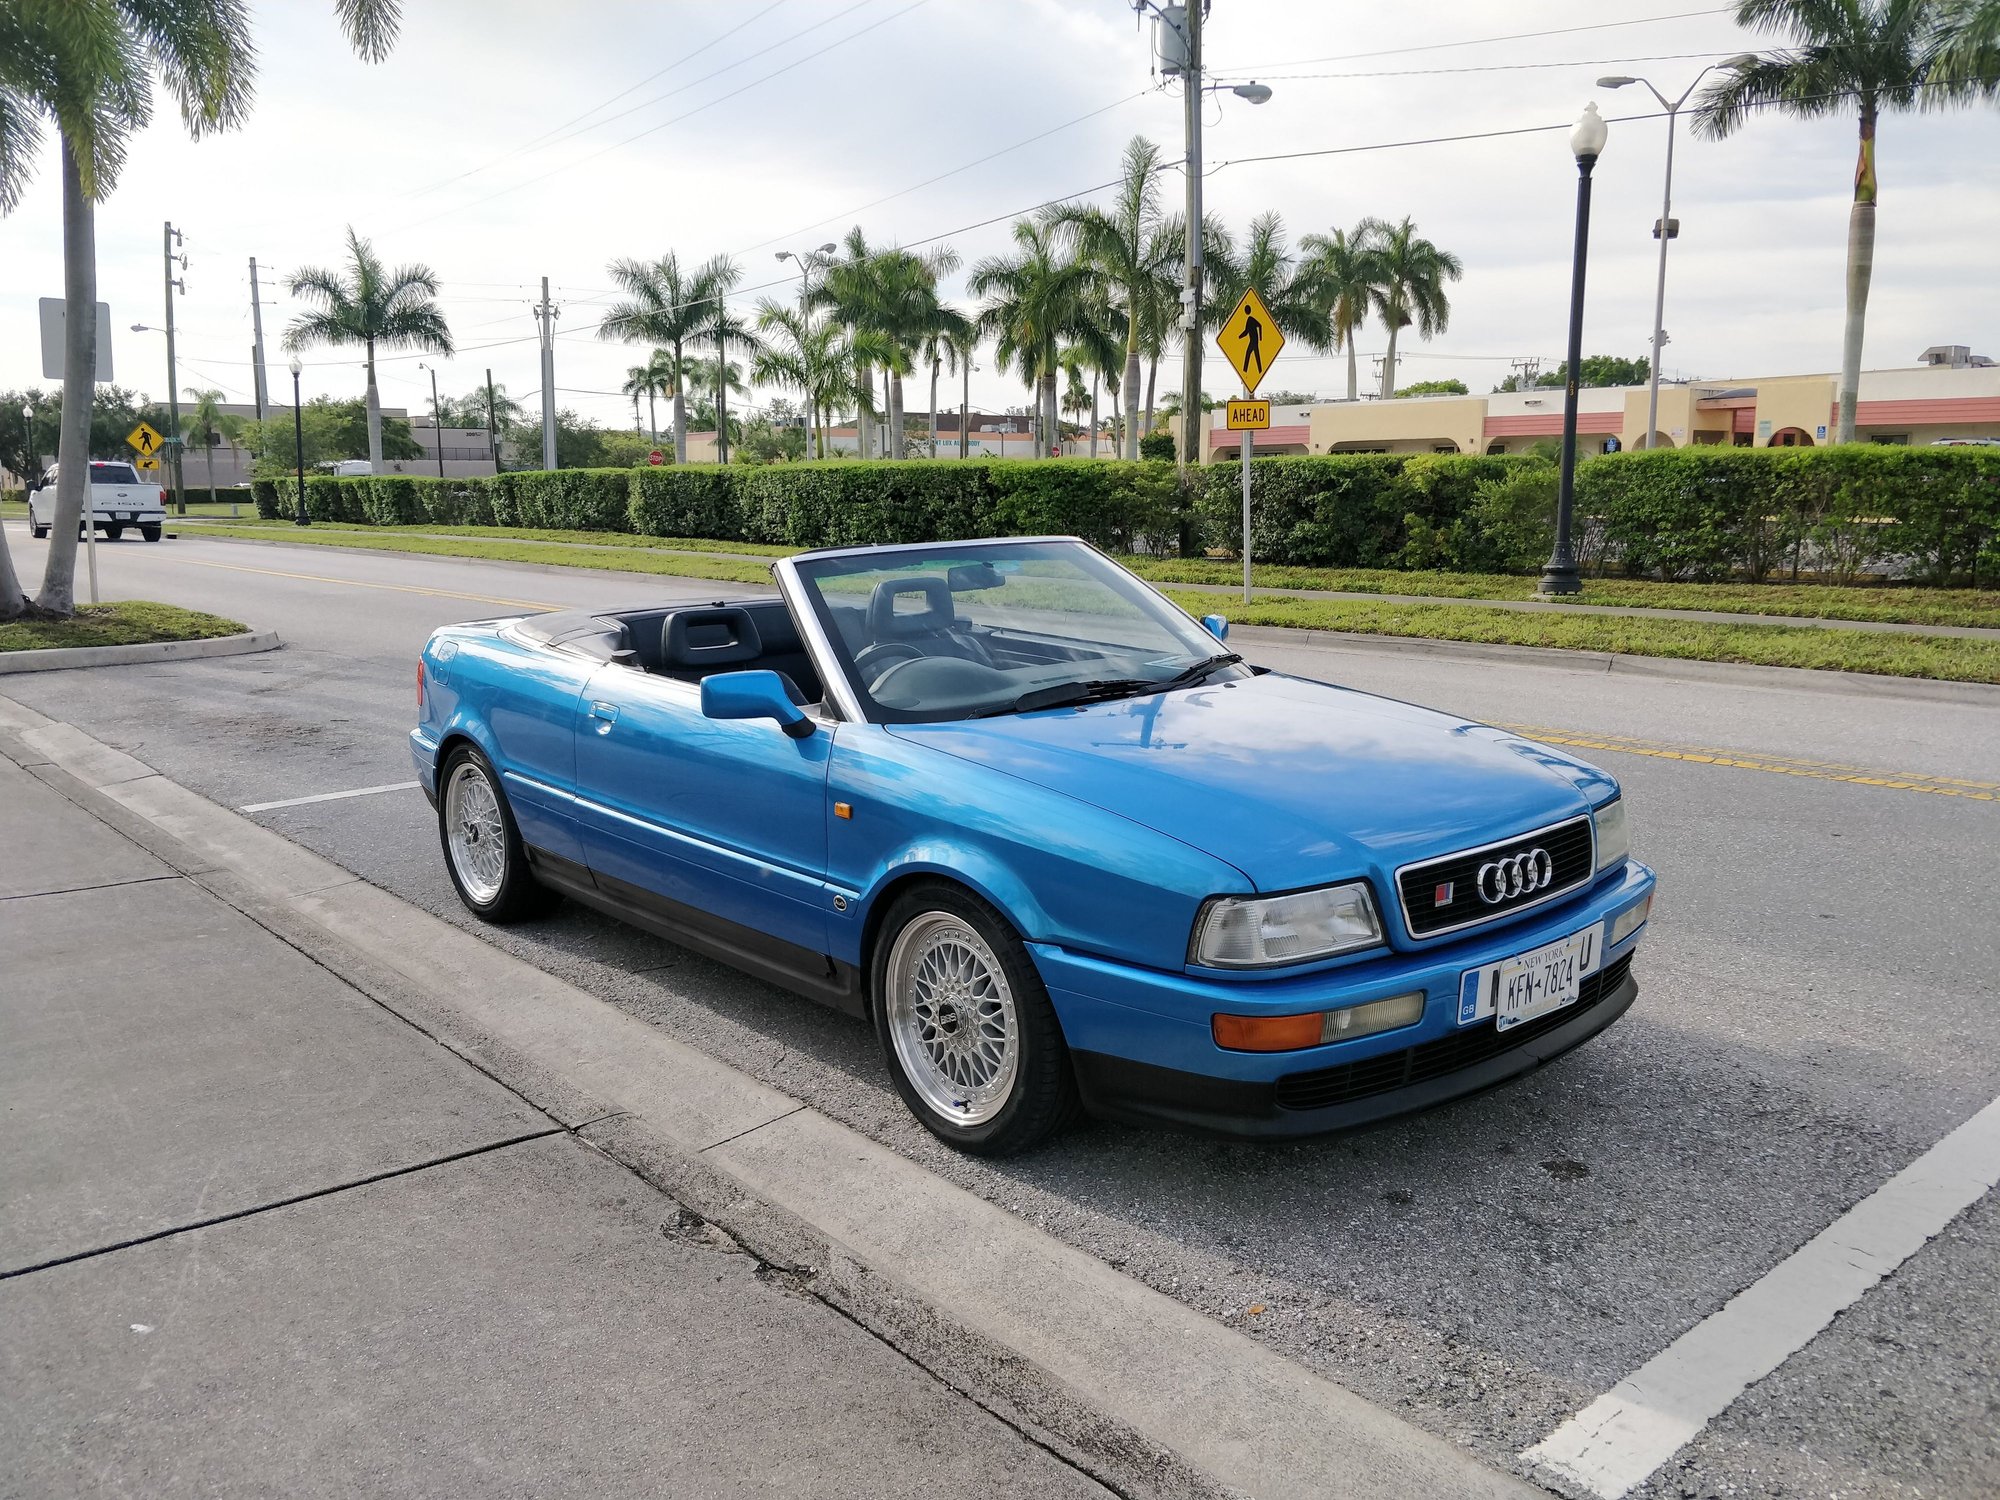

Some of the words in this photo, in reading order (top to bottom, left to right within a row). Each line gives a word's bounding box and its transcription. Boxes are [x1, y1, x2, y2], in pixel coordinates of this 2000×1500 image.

[1232, 407, 1265, 422] AHEAD
[1523, 953, 1542, 970] NEW
[1543, 947, 1564, 963] YORK
[1462, 1004, 1474, 1015] GB
